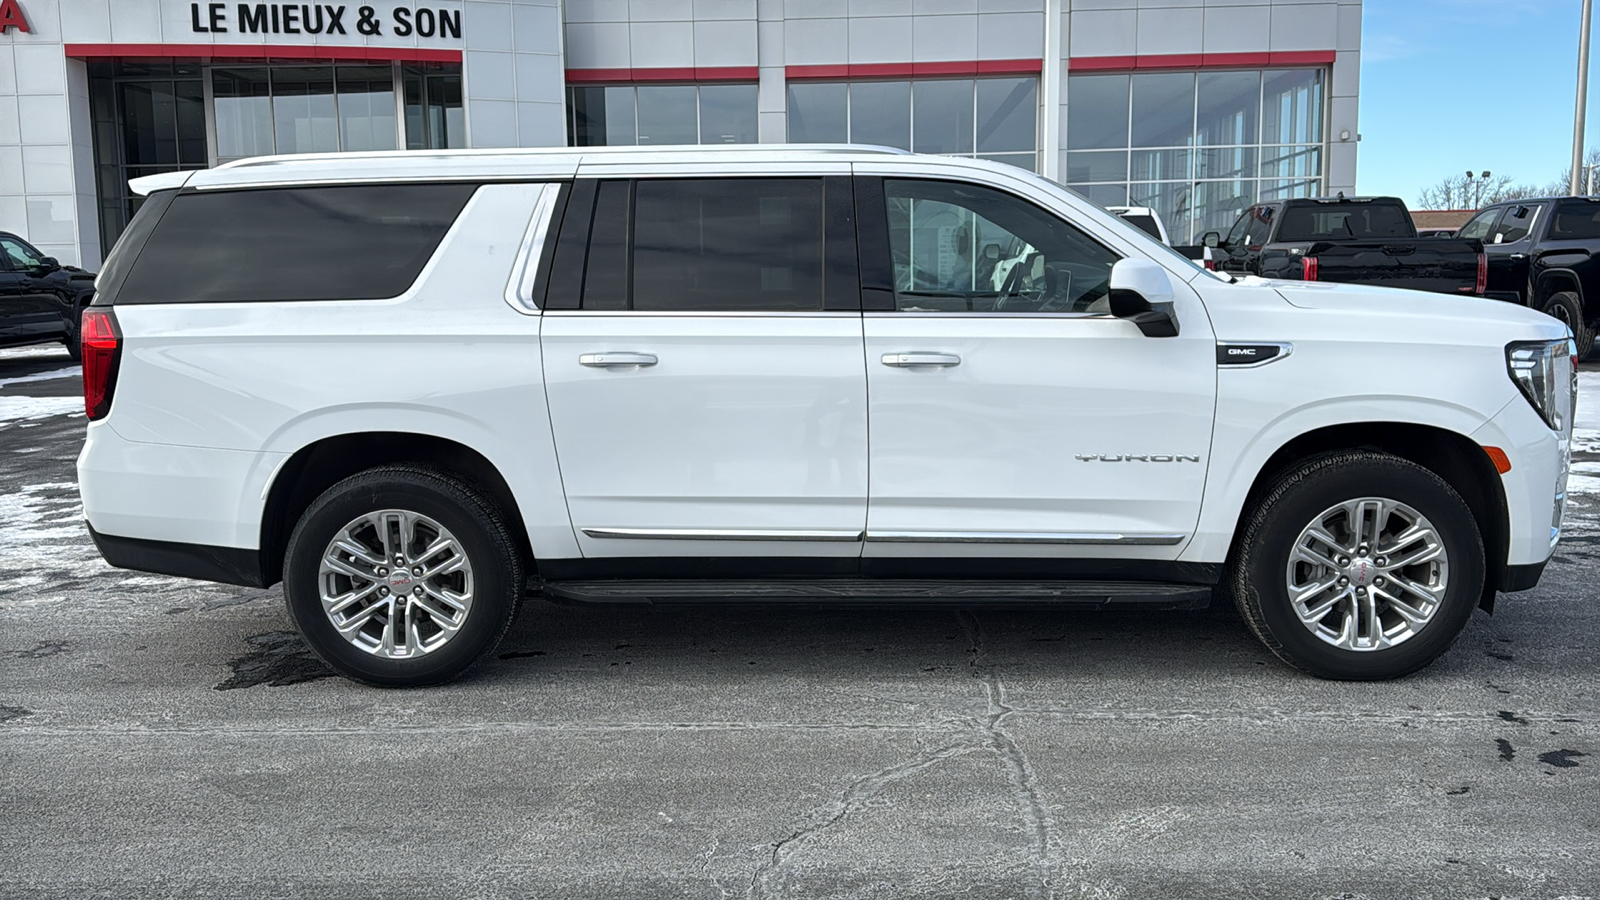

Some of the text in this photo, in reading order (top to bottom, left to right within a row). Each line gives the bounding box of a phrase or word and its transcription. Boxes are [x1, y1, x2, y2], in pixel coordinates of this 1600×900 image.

[191, 3, 461, 38] LE MIEUX & SON
[1074, 453, 1199, 462] YUKON
